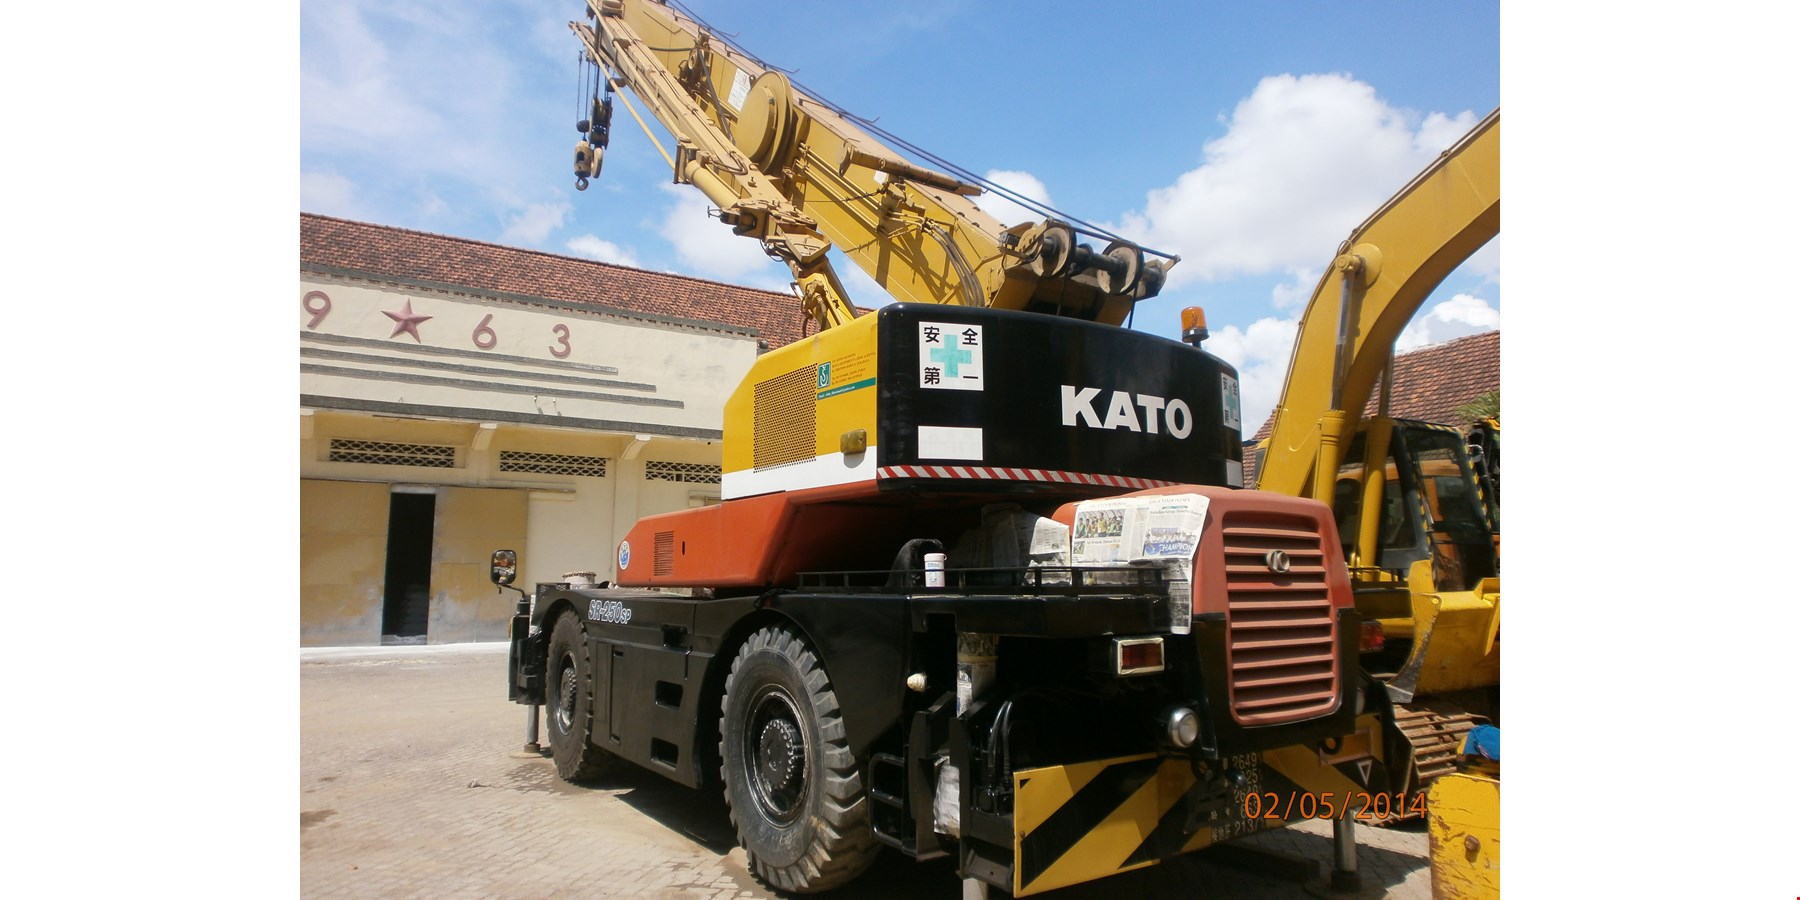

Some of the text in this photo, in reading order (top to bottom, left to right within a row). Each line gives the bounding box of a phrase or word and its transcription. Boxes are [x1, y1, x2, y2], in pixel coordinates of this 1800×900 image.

[302, 290, 572, 358] 9 6 3
[924, 326, 978, 346] 安全
[924, 367, 979, 385] 第一
[1061, 385, 1193, 440] KATO
[588, 599, 631, 625] SR-250SP
